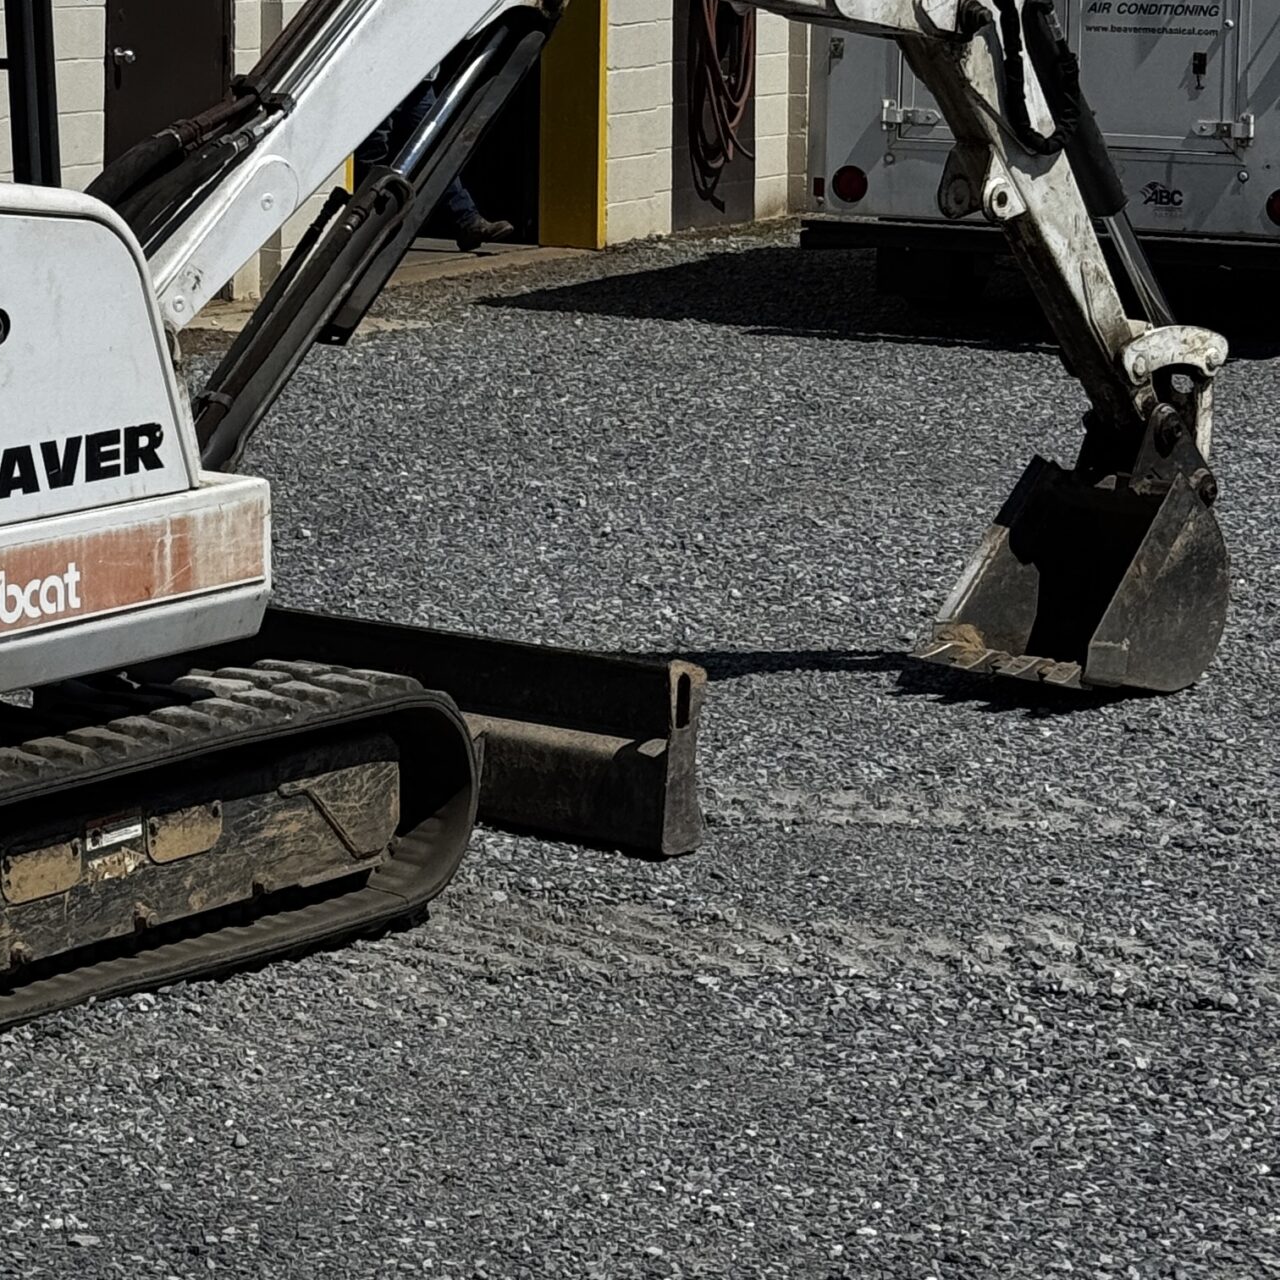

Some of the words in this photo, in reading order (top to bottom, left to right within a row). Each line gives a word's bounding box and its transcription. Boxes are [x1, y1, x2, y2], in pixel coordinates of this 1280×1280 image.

[1088, 2, 1111, 14] AIR
[1116, 2, 1220, 17] CONDITIONING
[1085, 24, 1219, 37] www.beavermechanical.com
[1143, 189, 1183, 206] ABC
